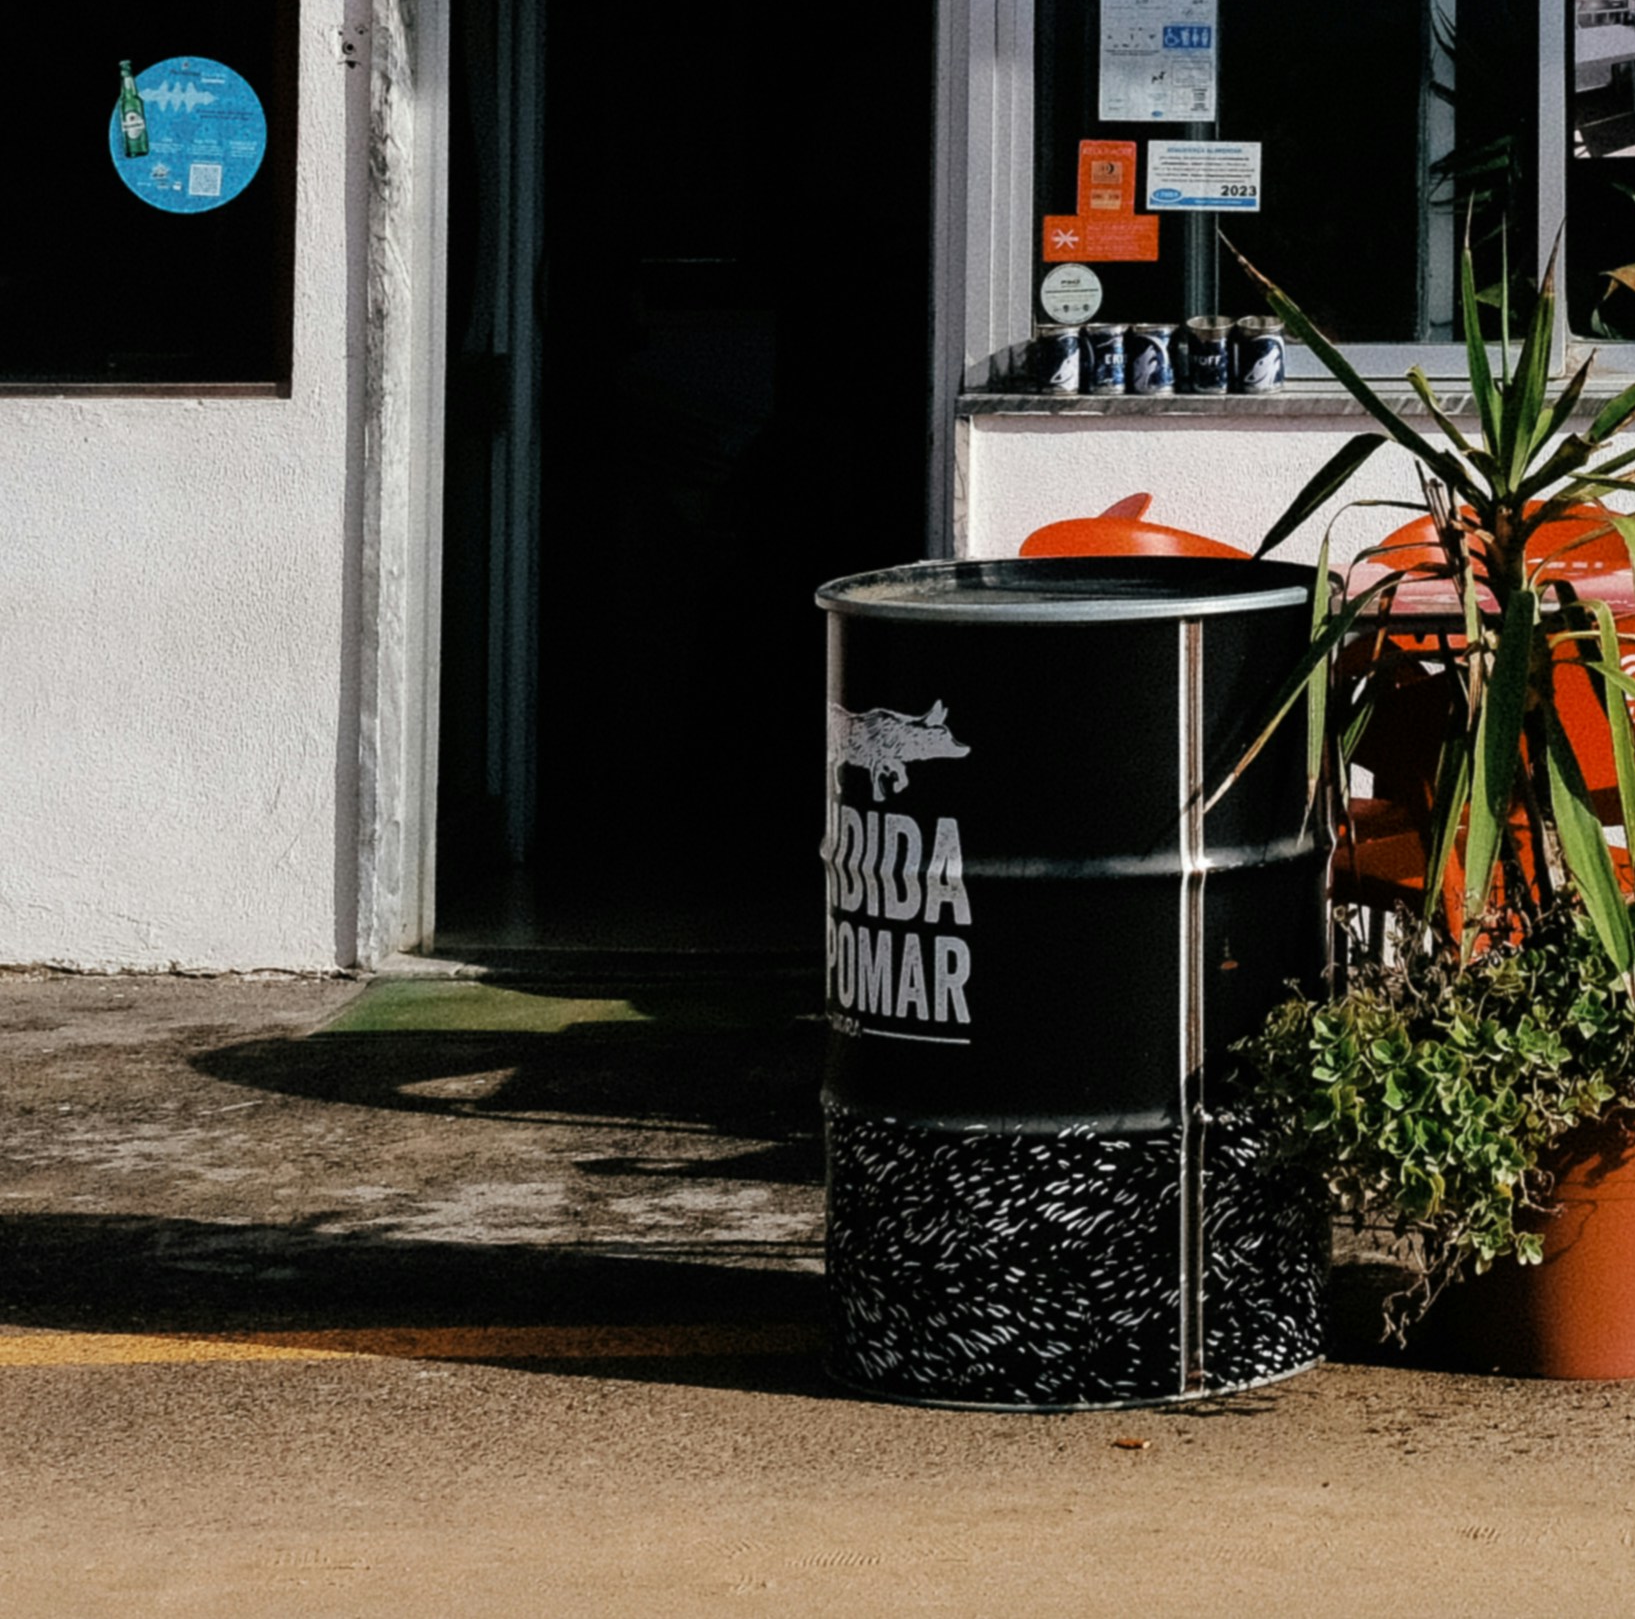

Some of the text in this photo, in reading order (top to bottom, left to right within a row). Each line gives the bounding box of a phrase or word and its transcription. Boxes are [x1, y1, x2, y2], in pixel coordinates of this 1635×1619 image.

[1221, 185, 1257, 197] 2023
[826, 801, 972, 925] DIDA
[826, 916, 972, 1025] POMAR
